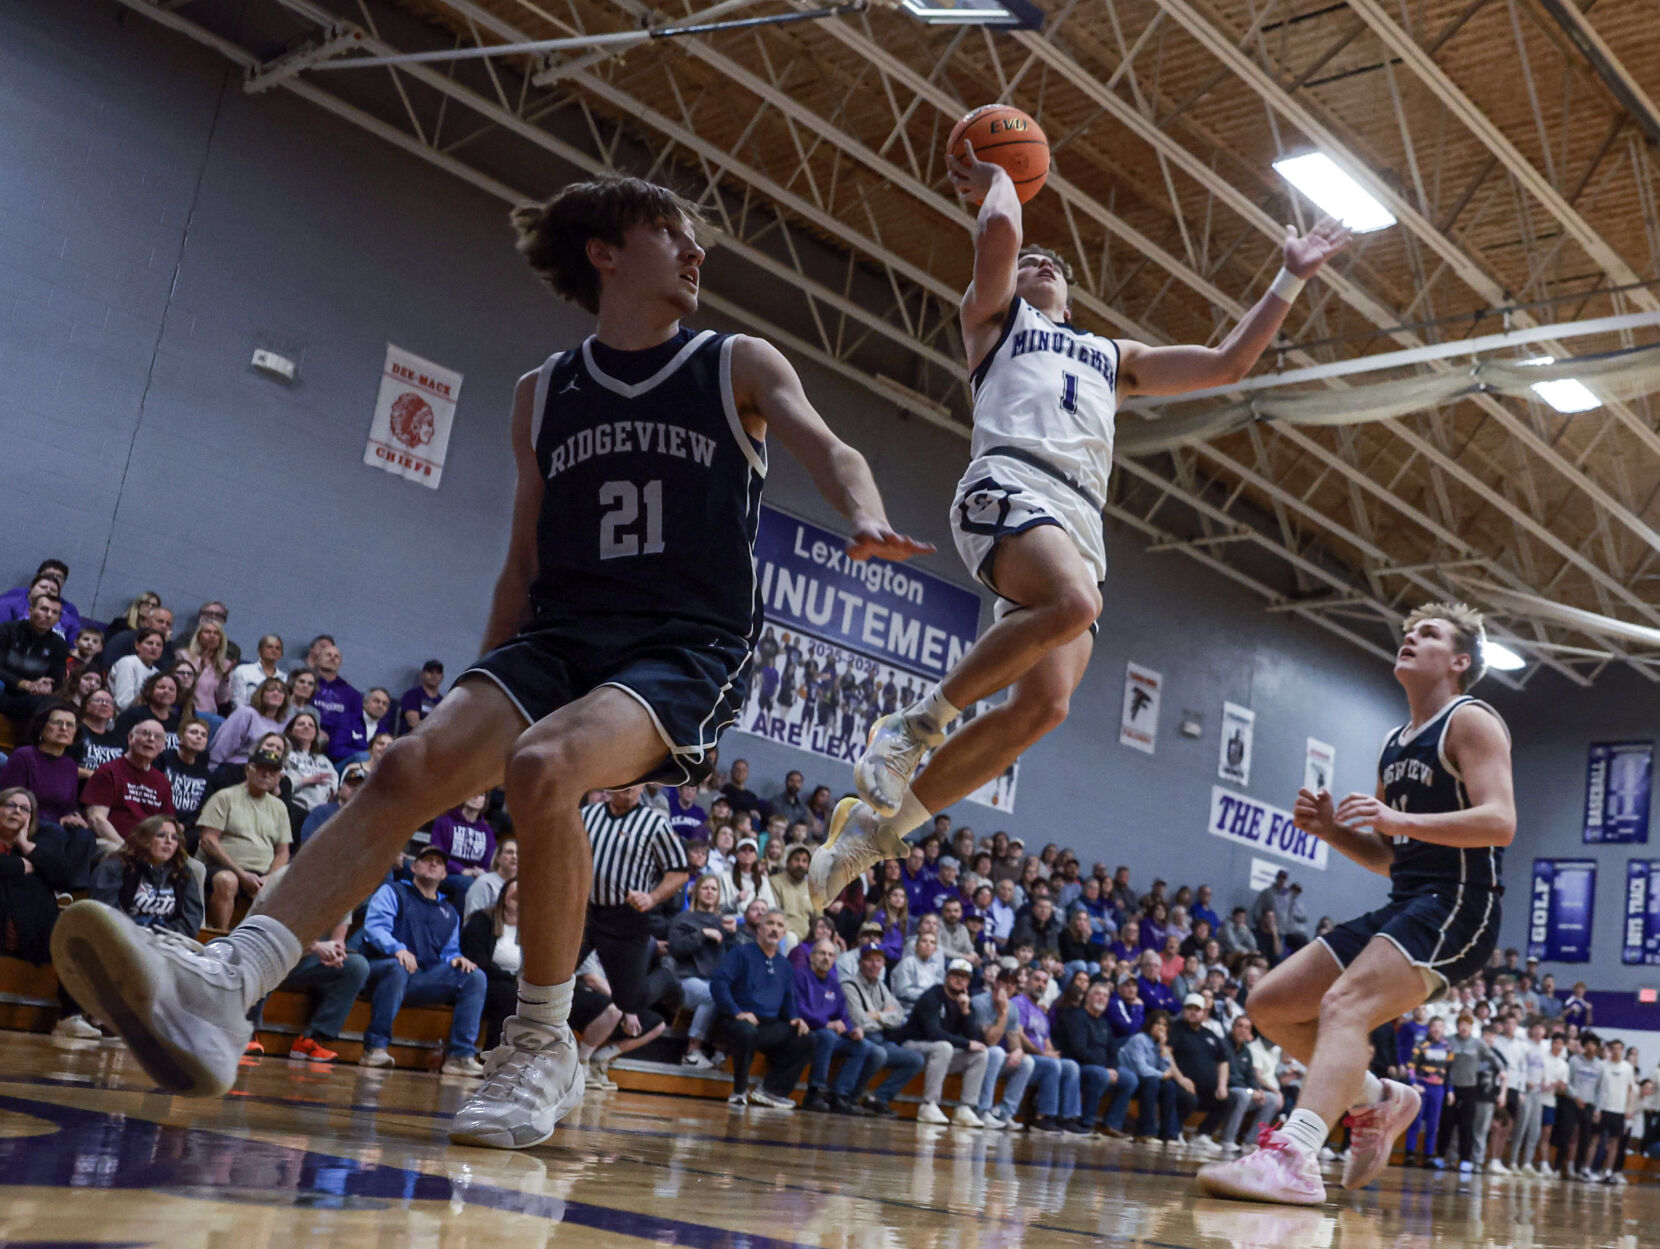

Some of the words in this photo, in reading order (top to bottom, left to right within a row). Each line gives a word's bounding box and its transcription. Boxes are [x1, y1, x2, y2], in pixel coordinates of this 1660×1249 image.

[391, 362, 452, 396] DEE-MACK
[1060, 370, 1079, 415] 1
[375, 447, 432, 476] CHIEFS
[548, 421, 717, 479] RIDGEVIEW
[599, 480, 666, 560] 21
[794, 526, 924, 605] Lexington
[753, 556, 974, 673] INUTEMEN
[751, 712, 802, 746] ARE
[1216, 795, 1264, 841] THE
[1531, 876, 1550, 942] GOLF
